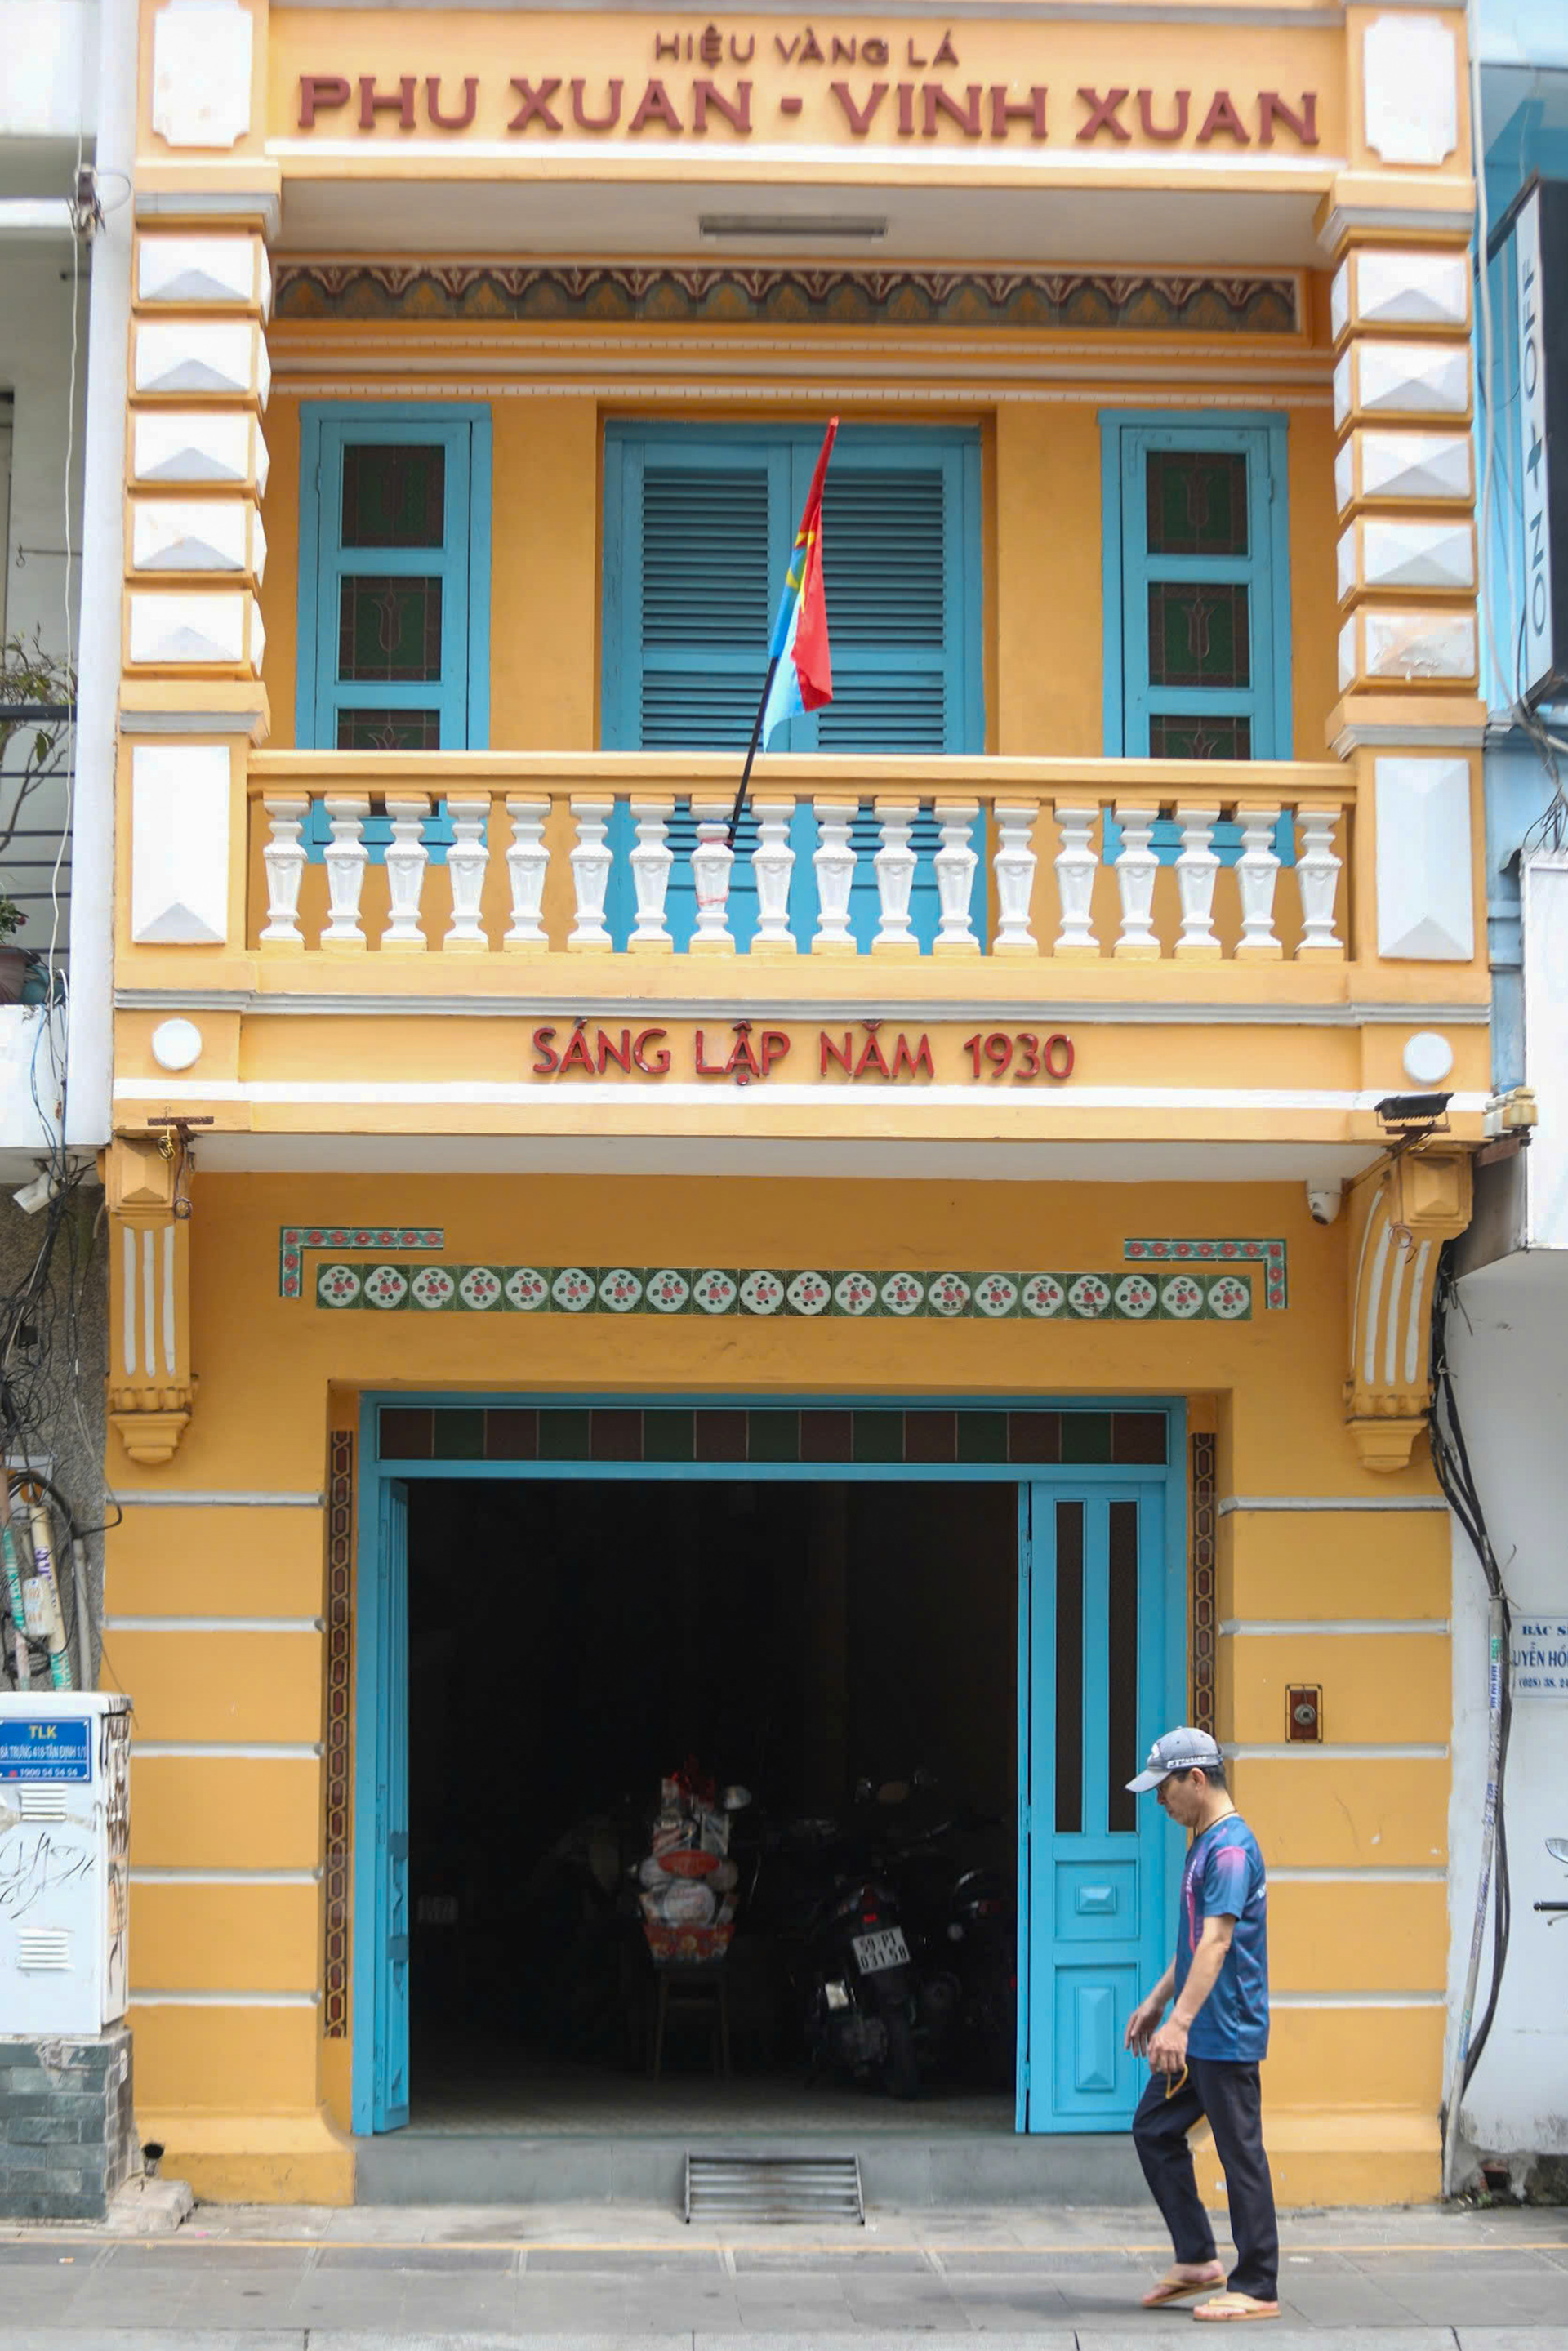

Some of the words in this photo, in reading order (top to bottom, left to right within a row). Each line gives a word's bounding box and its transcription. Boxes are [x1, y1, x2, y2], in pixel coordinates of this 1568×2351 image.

[656, 23, 755, 69] HIỆU
[774, 27, 889, 65] VÀNG
[907, 29, 959, 66] LÁ
[298, 74, 479, 130] PHU
[507, 78, 753, 134] XUAN
[830, 81, 1049, 138] VINH
[1075, 87, 1320, 145] XUAN
[532, 1017, 673, 1076] SÁNG
[695, 1019, 791, 1086] LẬP
[819, 1020, 935, 1078] NĂM
[962, 1032, 1076, 1080] 1930
[30, 1725, 57, 1739] TLK
